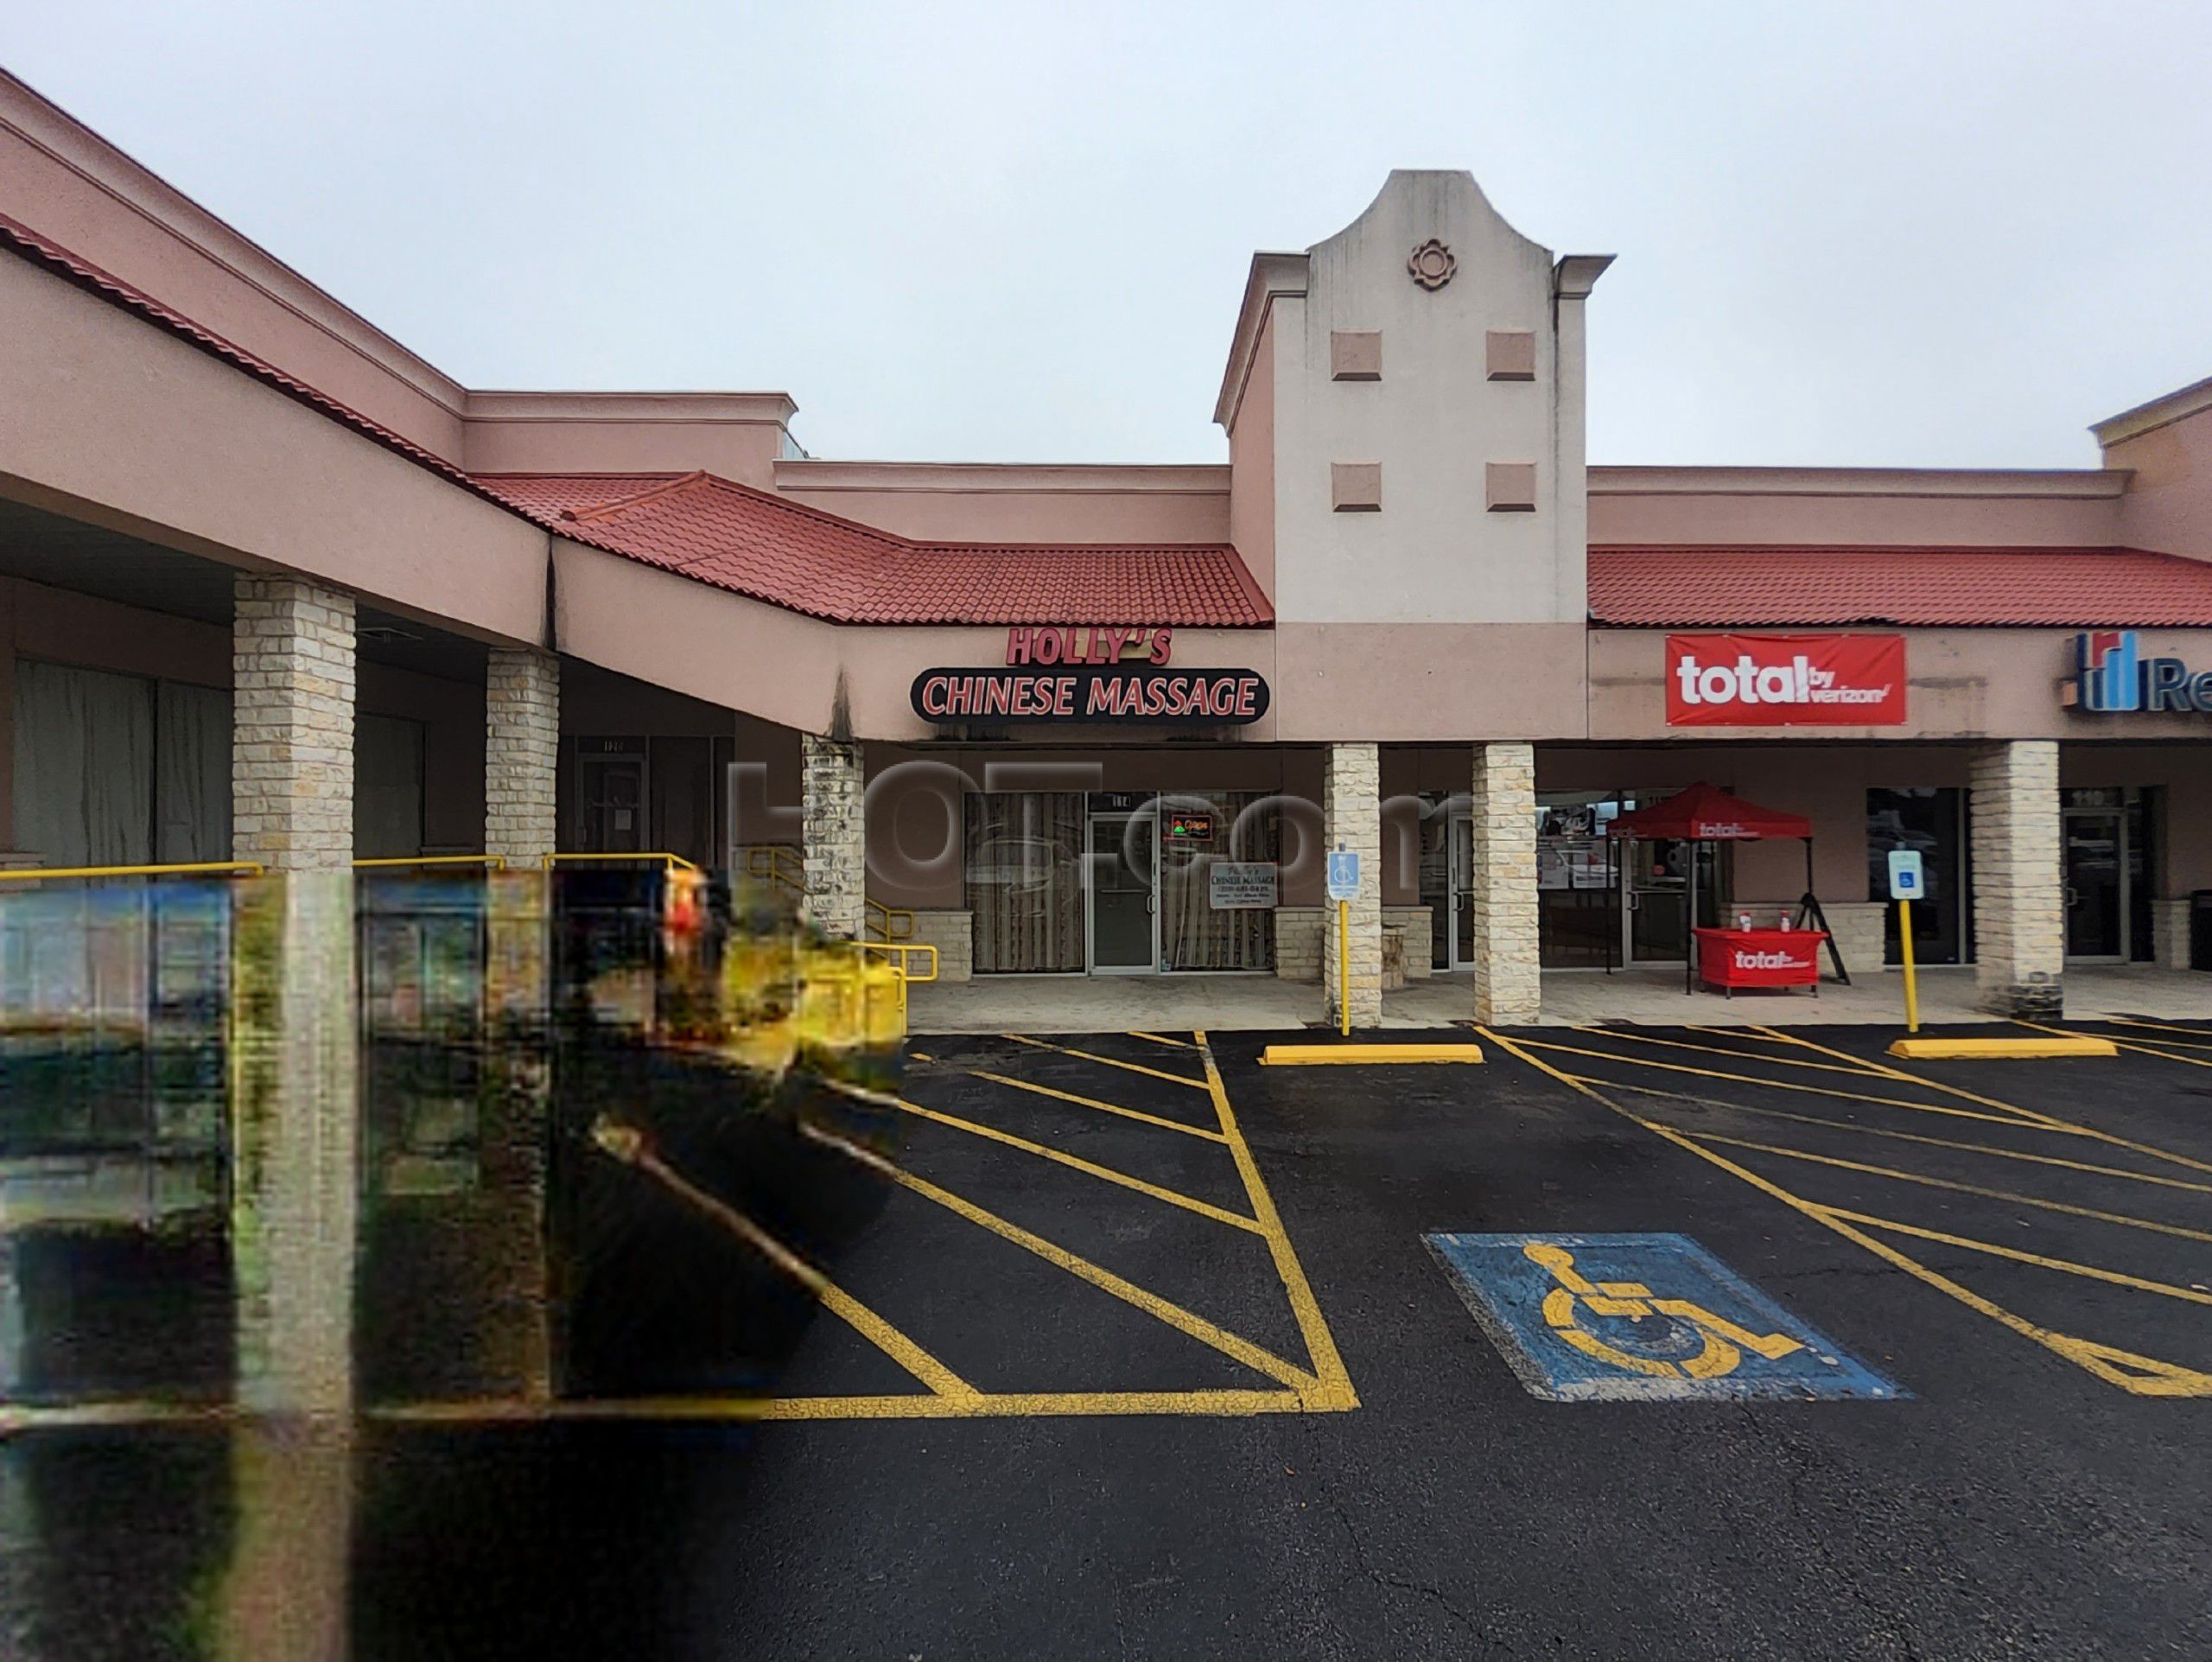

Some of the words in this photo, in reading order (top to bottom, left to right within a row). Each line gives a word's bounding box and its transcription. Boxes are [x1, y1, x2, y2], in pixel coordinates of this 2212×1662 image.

[1006, 627, 1173, 665] HOLLY'S
[922, 677, 1077, 716] CHINESE
[1086, 678, 1259, 716] MASSAGE
[1676, 655, 1809, 704] total
[1809, 666, 1834, 688] by
[1809, 685, 1885, 704] verizon
[1735, 951, 1784, 969] total
